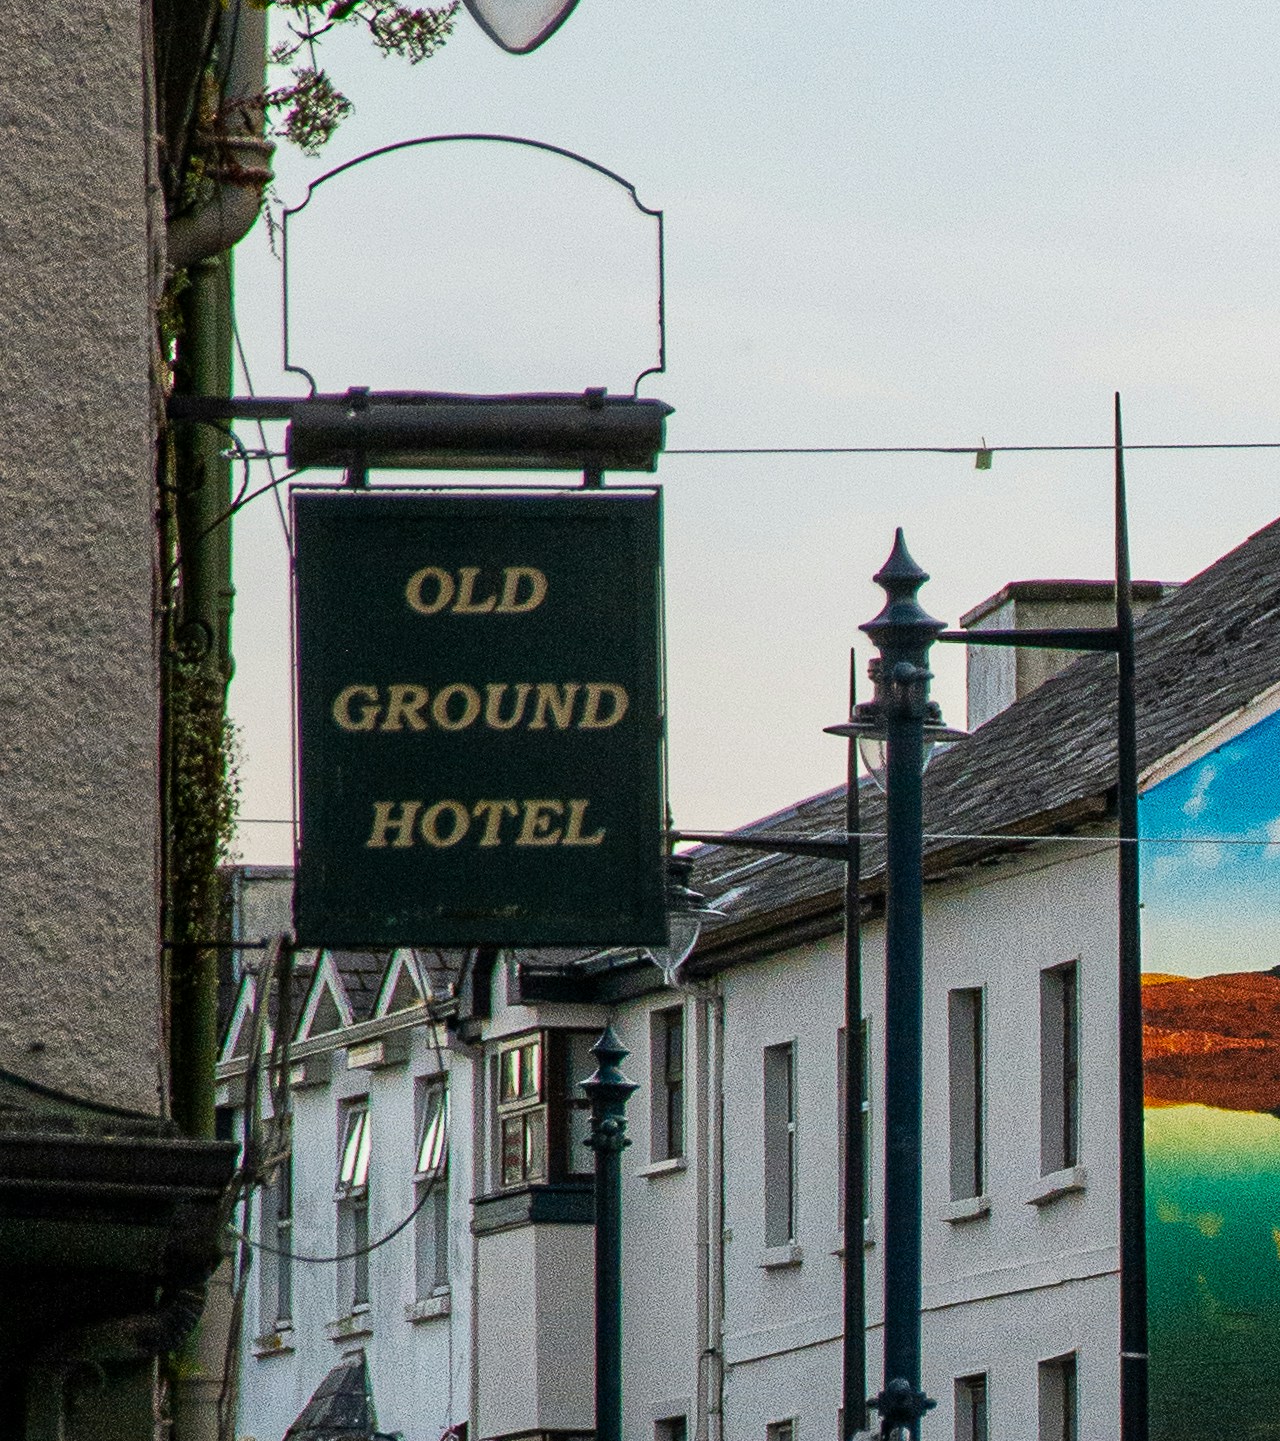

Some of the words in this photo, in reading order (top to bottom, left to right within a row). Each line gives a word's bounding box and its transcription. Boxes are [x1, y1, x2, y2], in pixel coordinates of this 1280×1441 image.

[405, 565, 550, 615] OLD
[332, 681, 630, 733] GROUND
[366, 799, 606, 850] HOTEL
